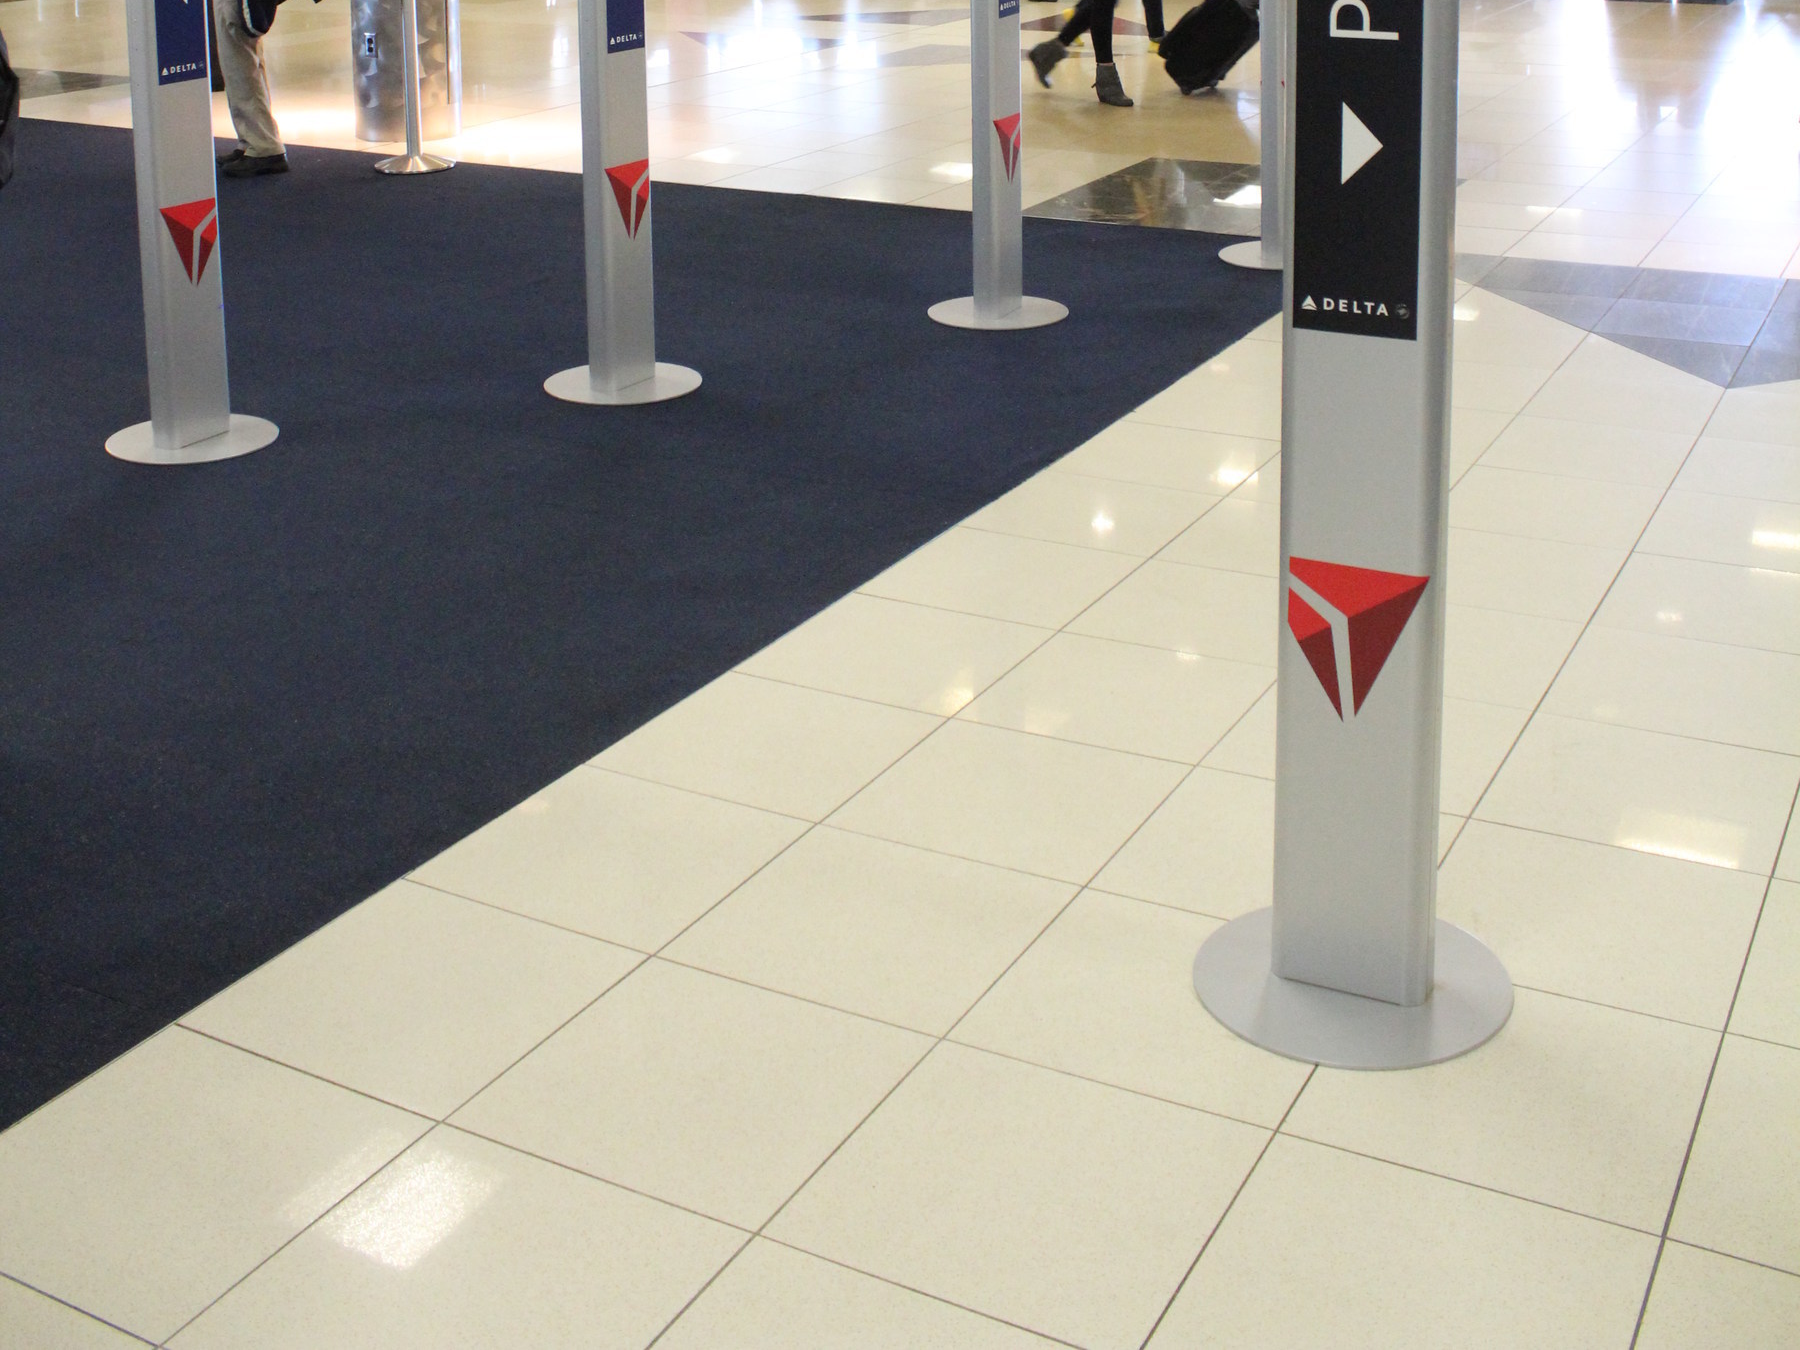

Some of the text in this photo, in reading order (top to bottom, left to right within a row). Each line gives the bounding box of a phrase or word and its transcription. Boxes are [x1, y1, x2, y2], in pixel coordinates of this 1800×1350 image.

[1003, 0, 1016, 10] DELTA
[616, 33, 638, 44] DELTA
[170, 62, 197, 74] DELTA
[1322, 297, 1389, 317] DELTA
